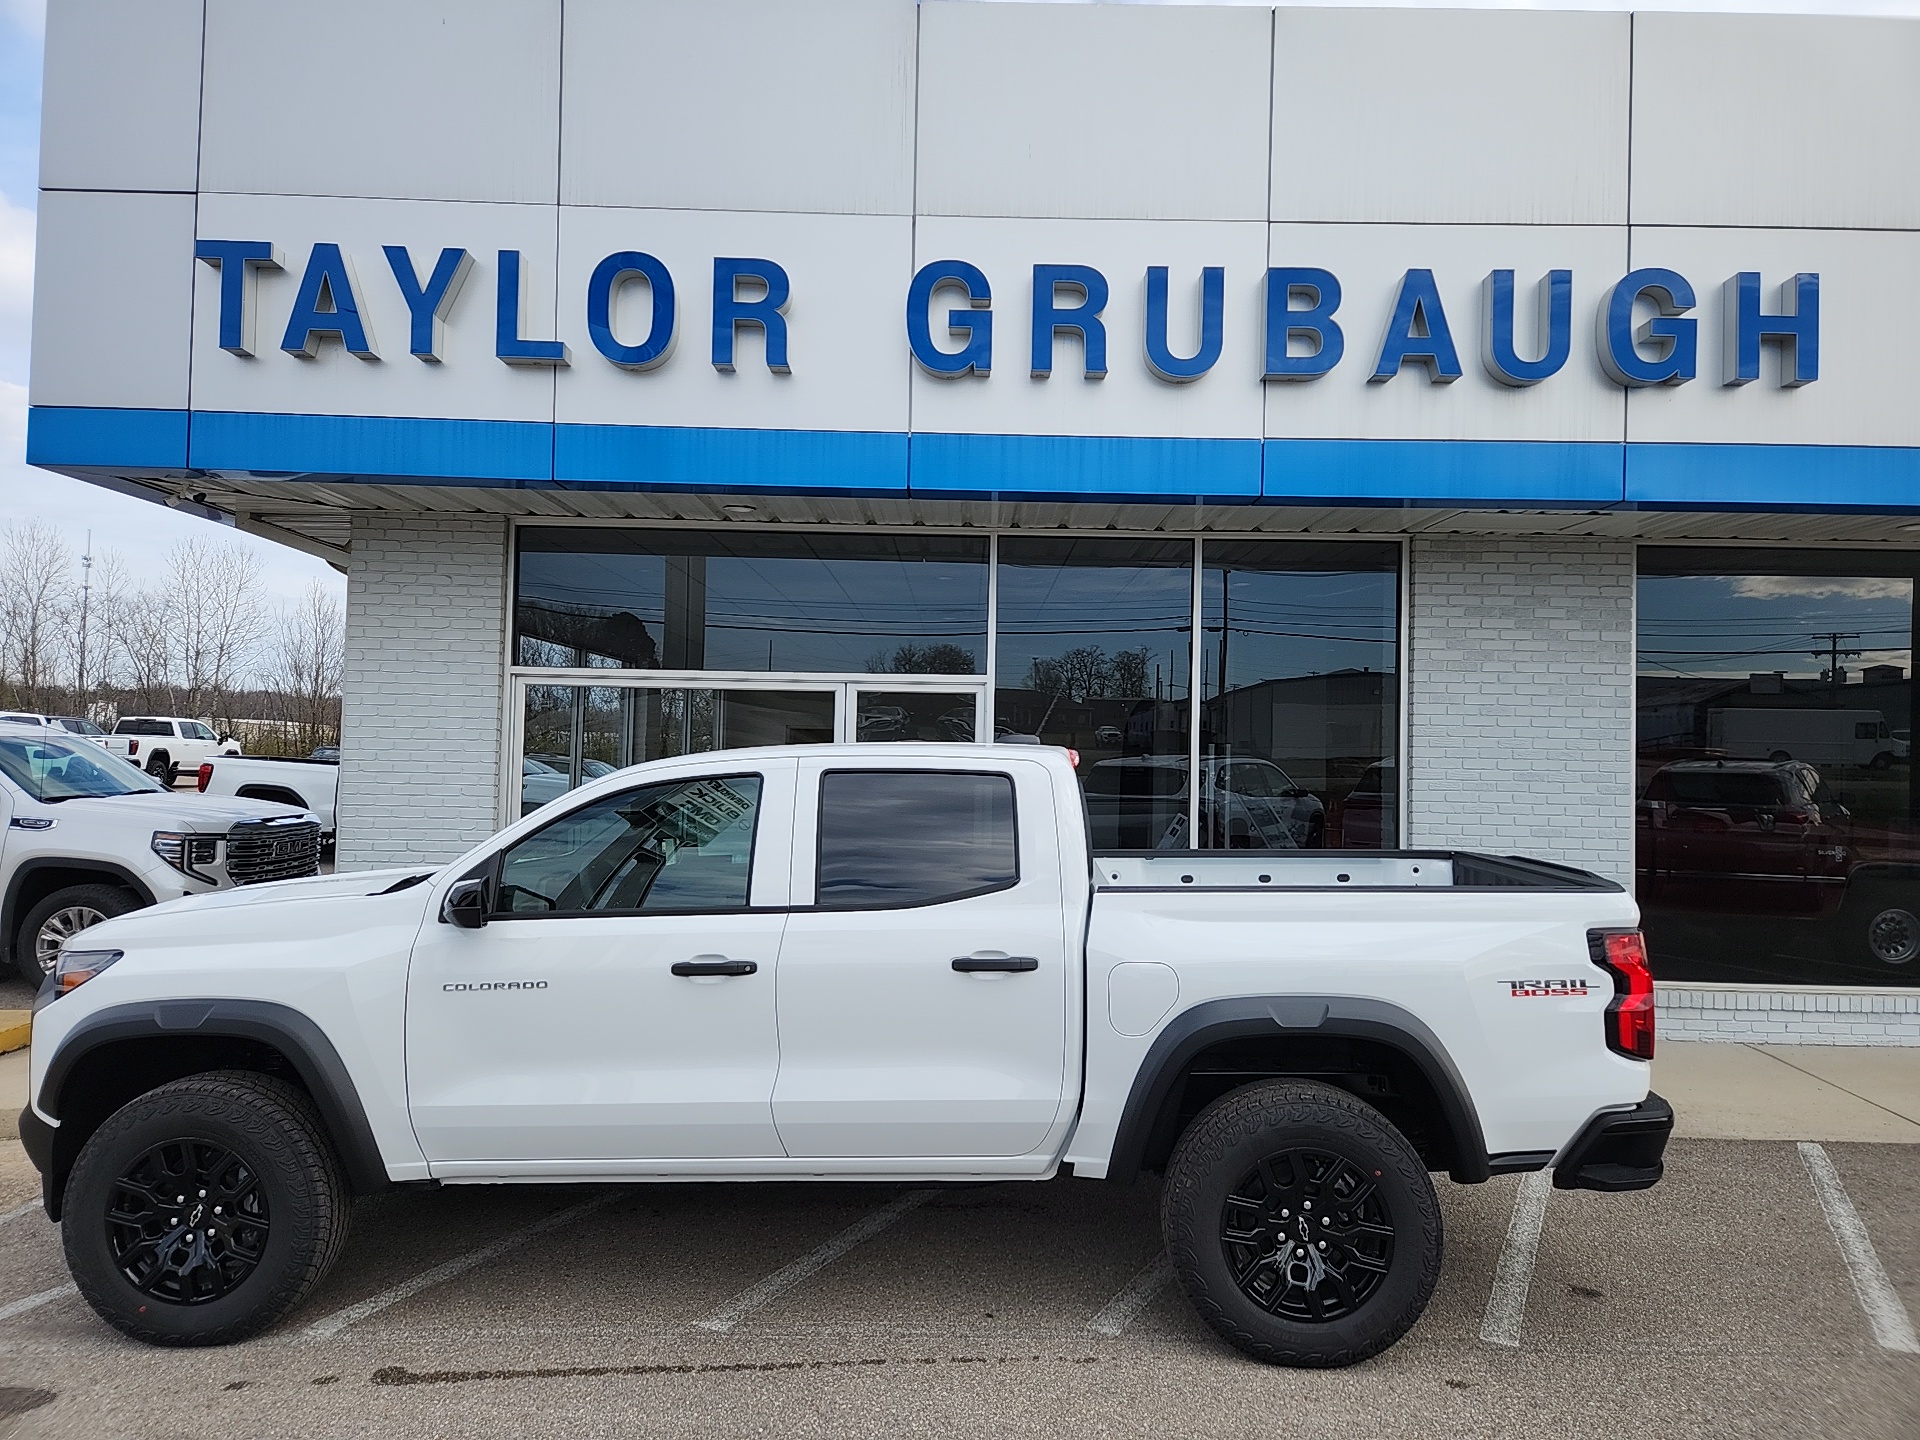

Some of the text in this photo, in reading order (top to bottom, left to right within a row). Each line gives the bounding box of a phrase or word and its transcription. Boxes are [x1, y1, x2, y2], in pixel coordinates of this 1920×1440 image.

[195, 239, 1820, 388] TAYLOR GRUBAUGH
[277, 840, 309, 855] GMC
[443, 981, 548, 991] COLORADO
[1497, 979, 1600, 989] TRAIL
[1512, 988, 1588, 997] BOSS
